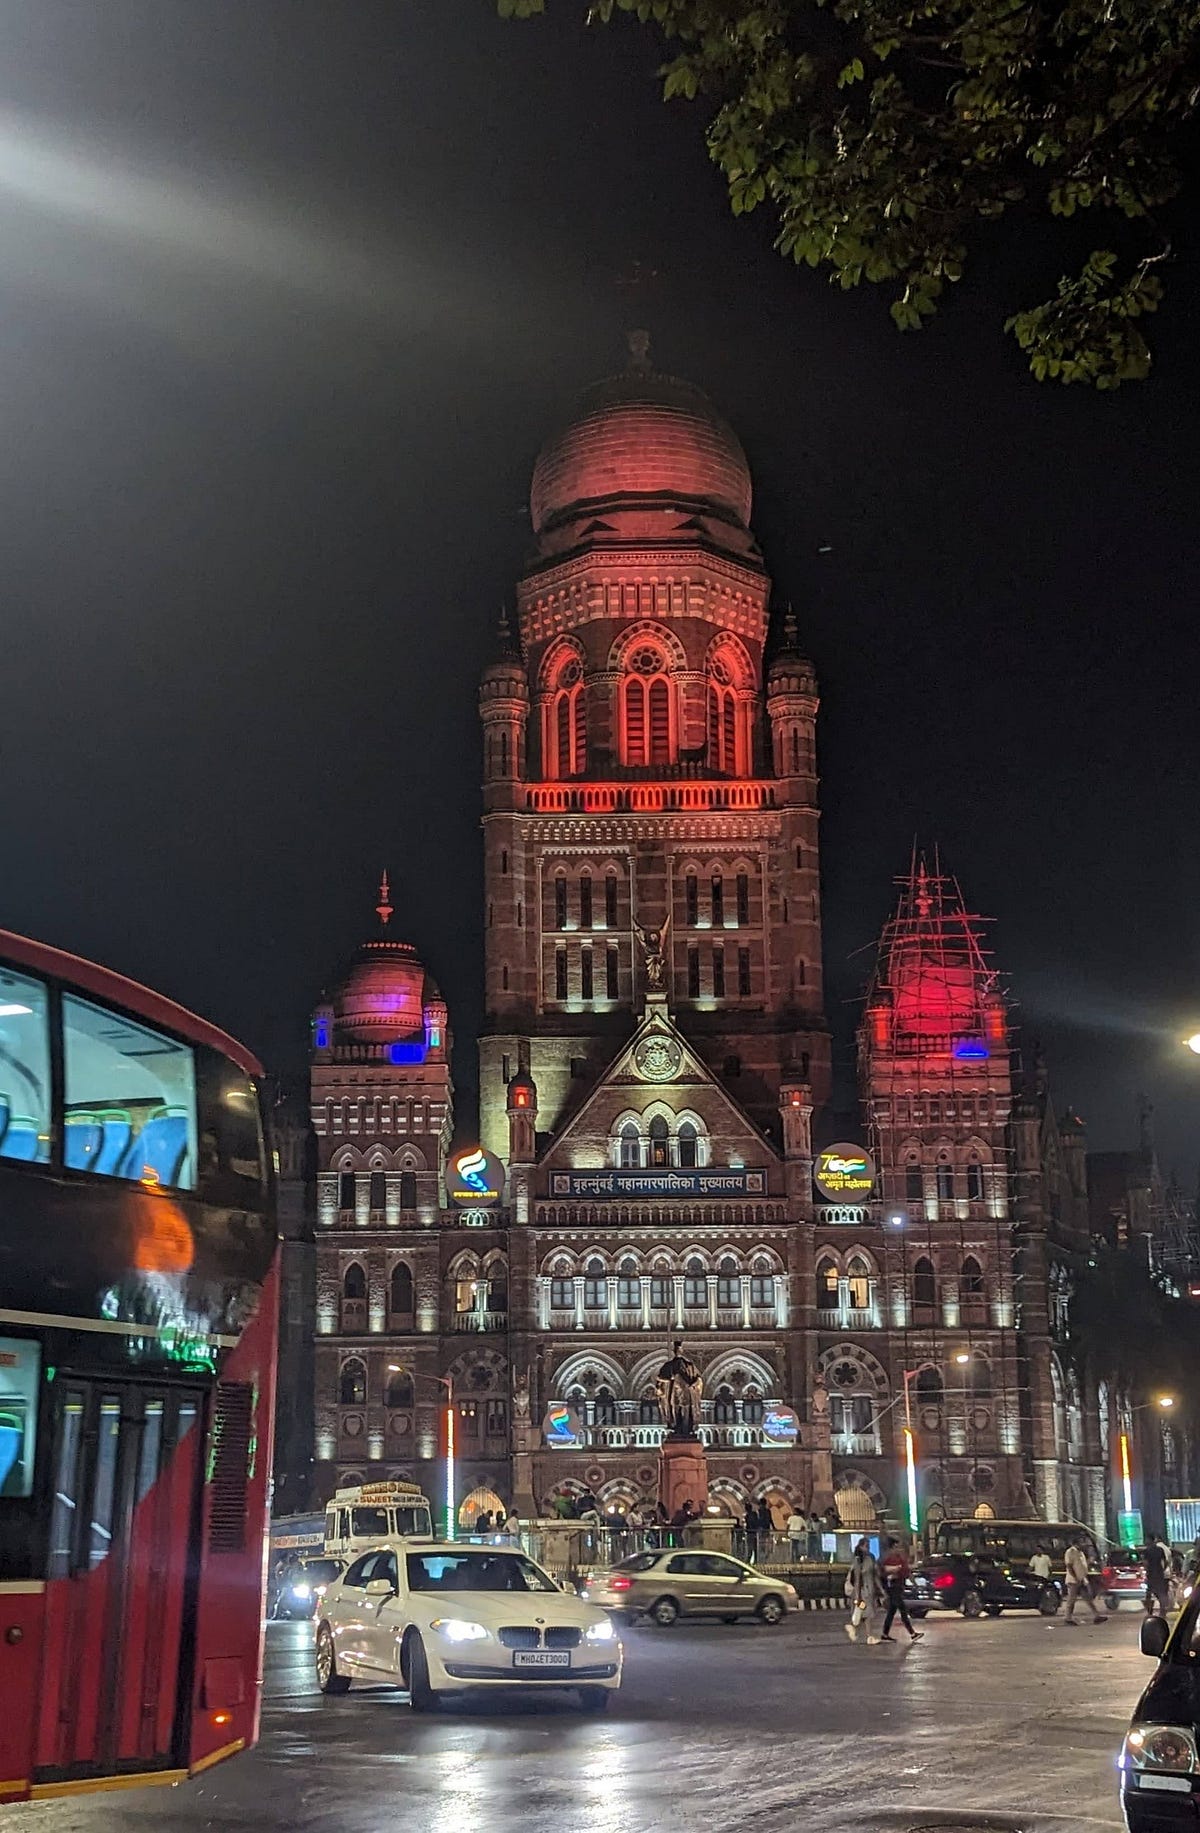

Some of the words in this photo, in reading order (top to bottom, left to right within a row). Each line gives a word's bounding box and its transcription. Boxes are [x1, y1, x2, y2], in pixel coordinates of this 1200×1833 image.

[572, 1174, 614, 1194] बृहन्मुंबई
[617, 1173, 695, 1189] महानगरपालिका
[699, 1176, 743, 1193] मुख्यालय
